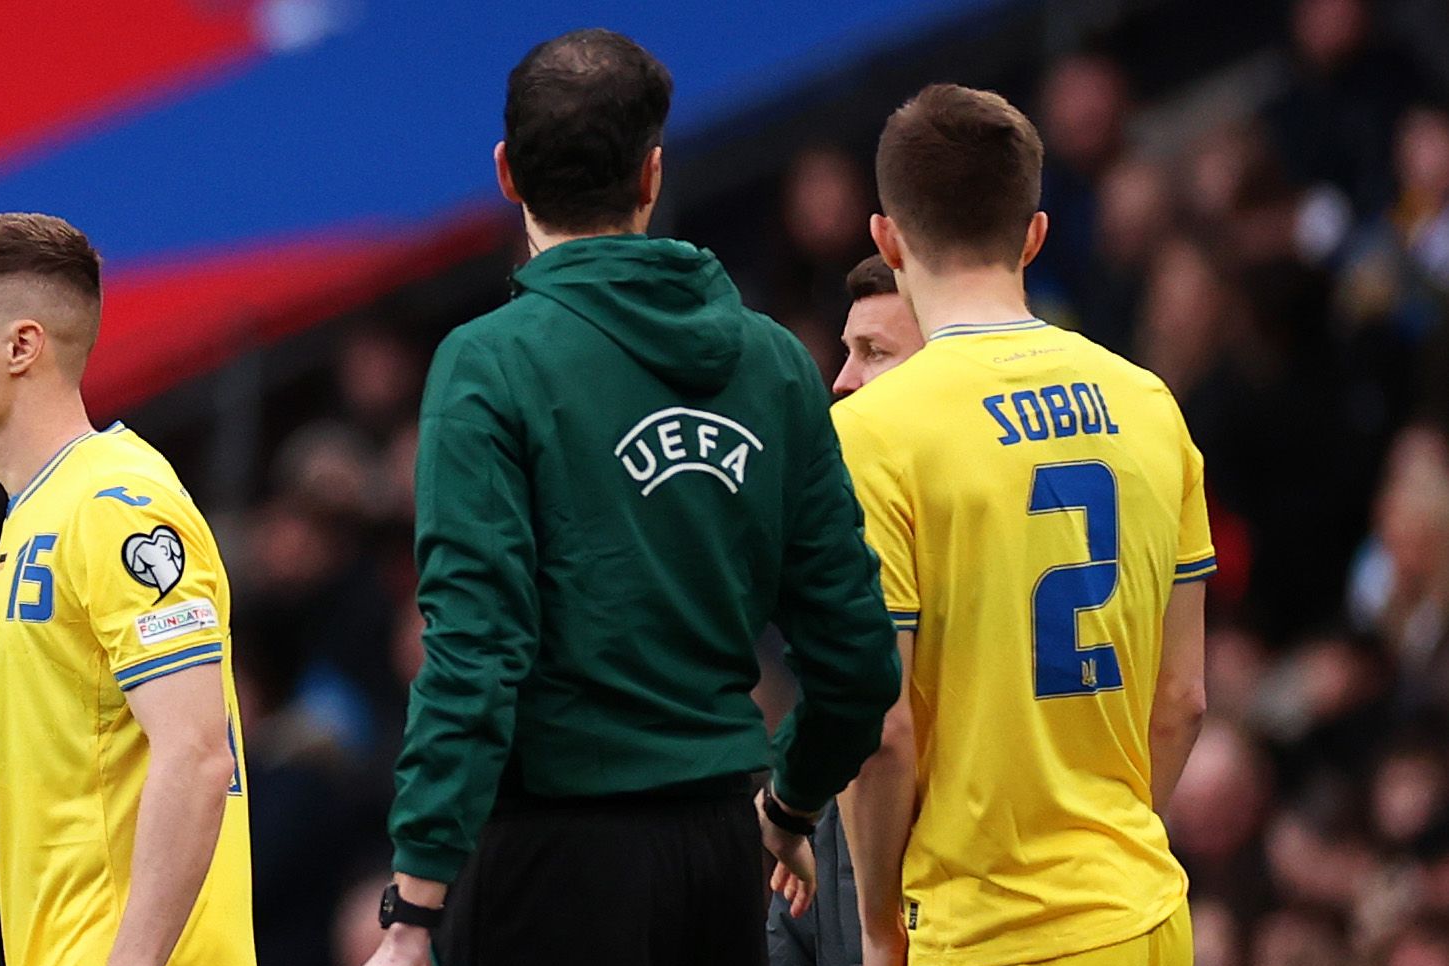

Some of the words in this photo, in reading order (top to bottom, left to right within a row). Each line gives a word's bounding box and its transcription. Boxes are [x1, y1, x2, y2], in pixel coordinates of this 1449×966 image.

[622, 420, 749, 484] UEFA
[982, 382, 1120, 446] SOBOL
[6, 533, 59, 623] 15
[1027, 459, 1124, 700] 2
